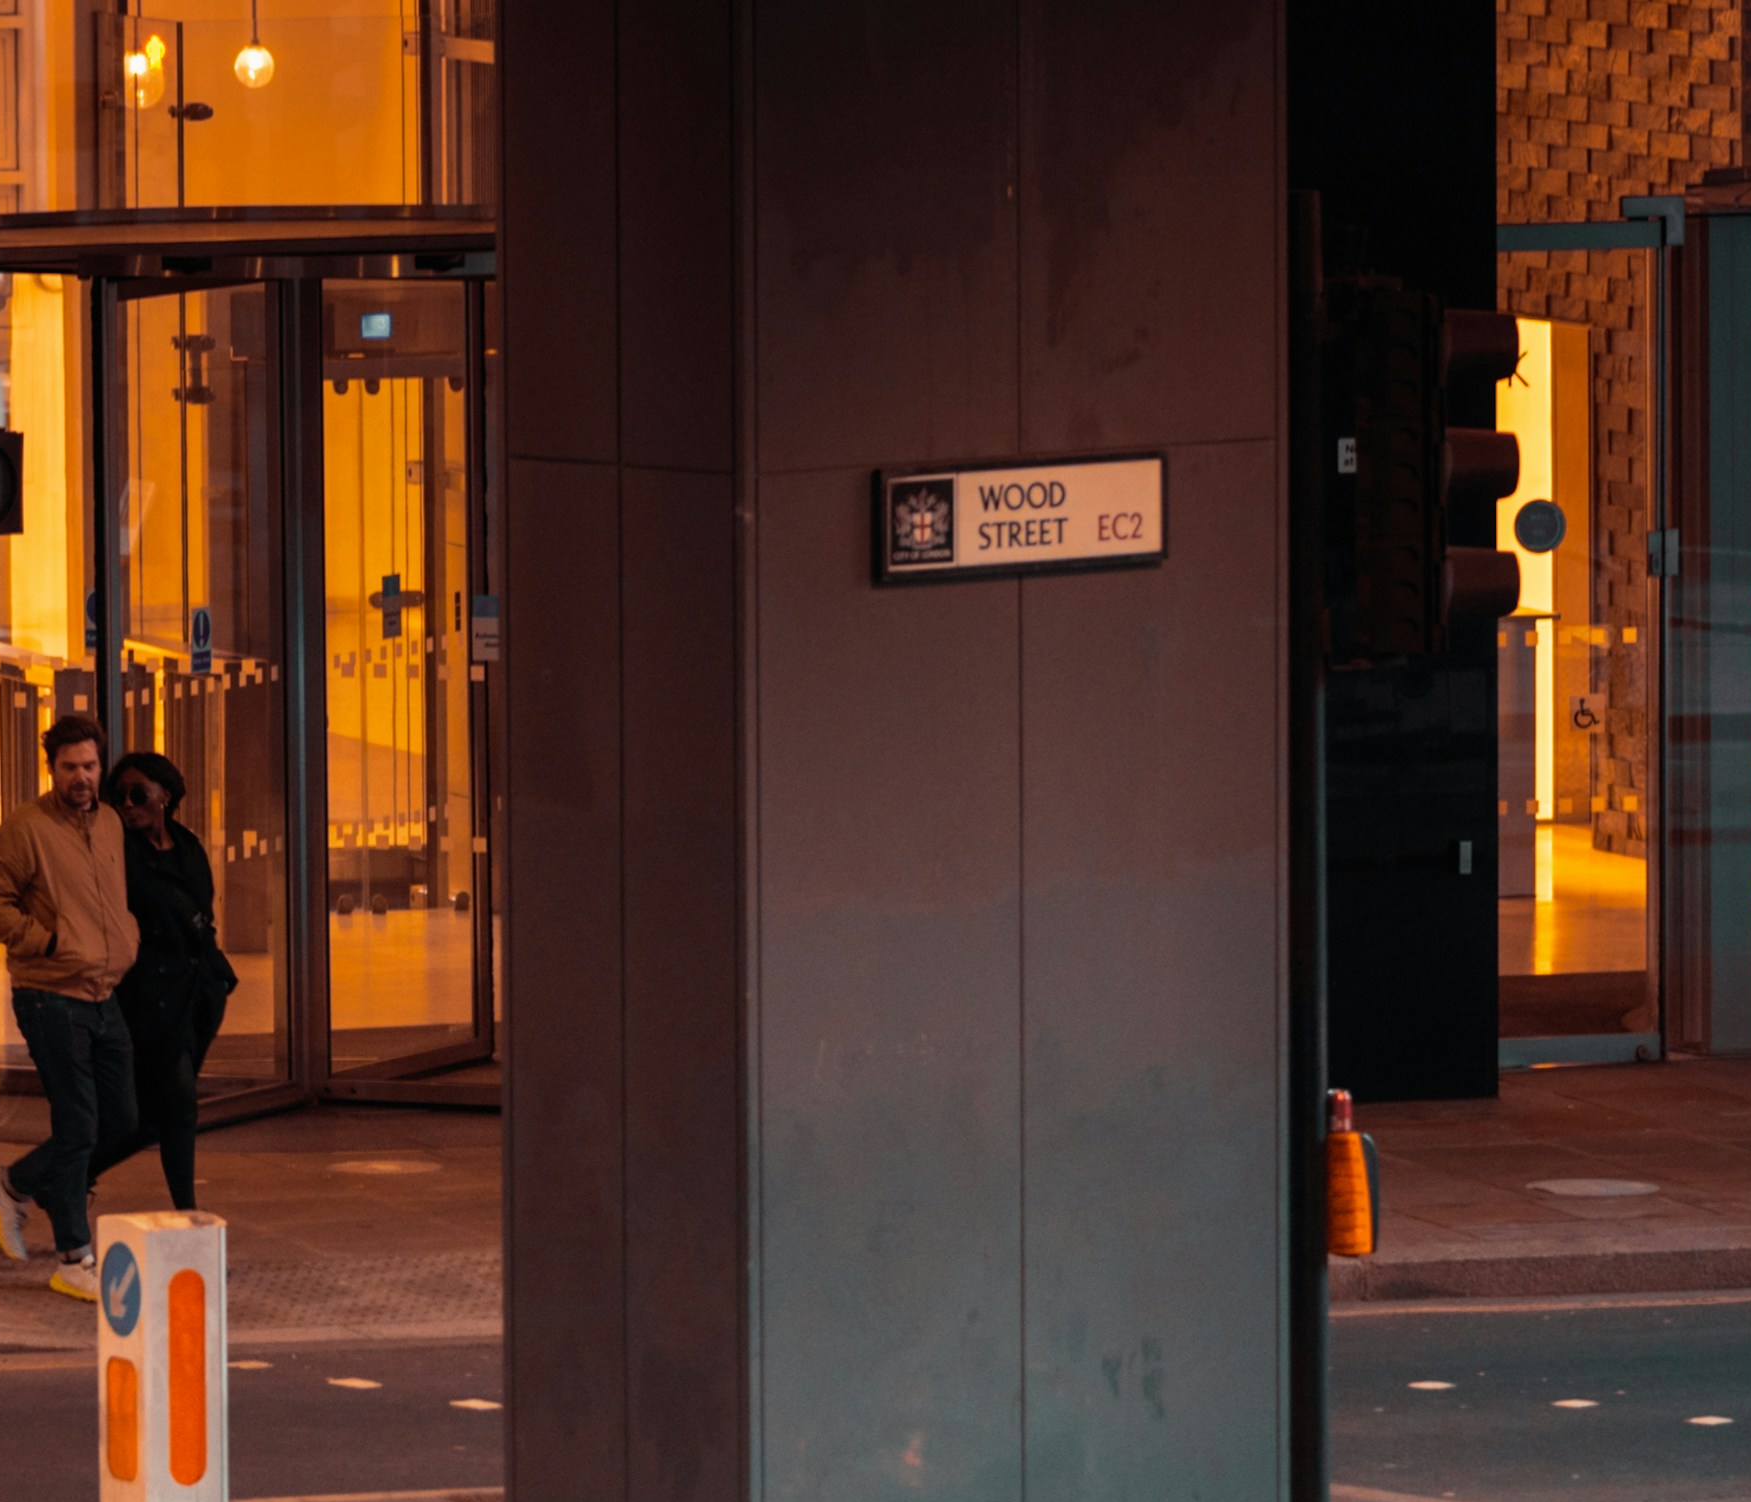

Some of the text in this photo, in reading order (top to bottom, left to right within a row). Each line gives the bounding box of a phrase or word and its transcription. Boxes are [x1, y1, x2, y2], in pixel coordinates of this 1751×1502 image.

[979, 480, 1067, 512] WOOD
[978, 512, 1144, 551] STREET EC2
